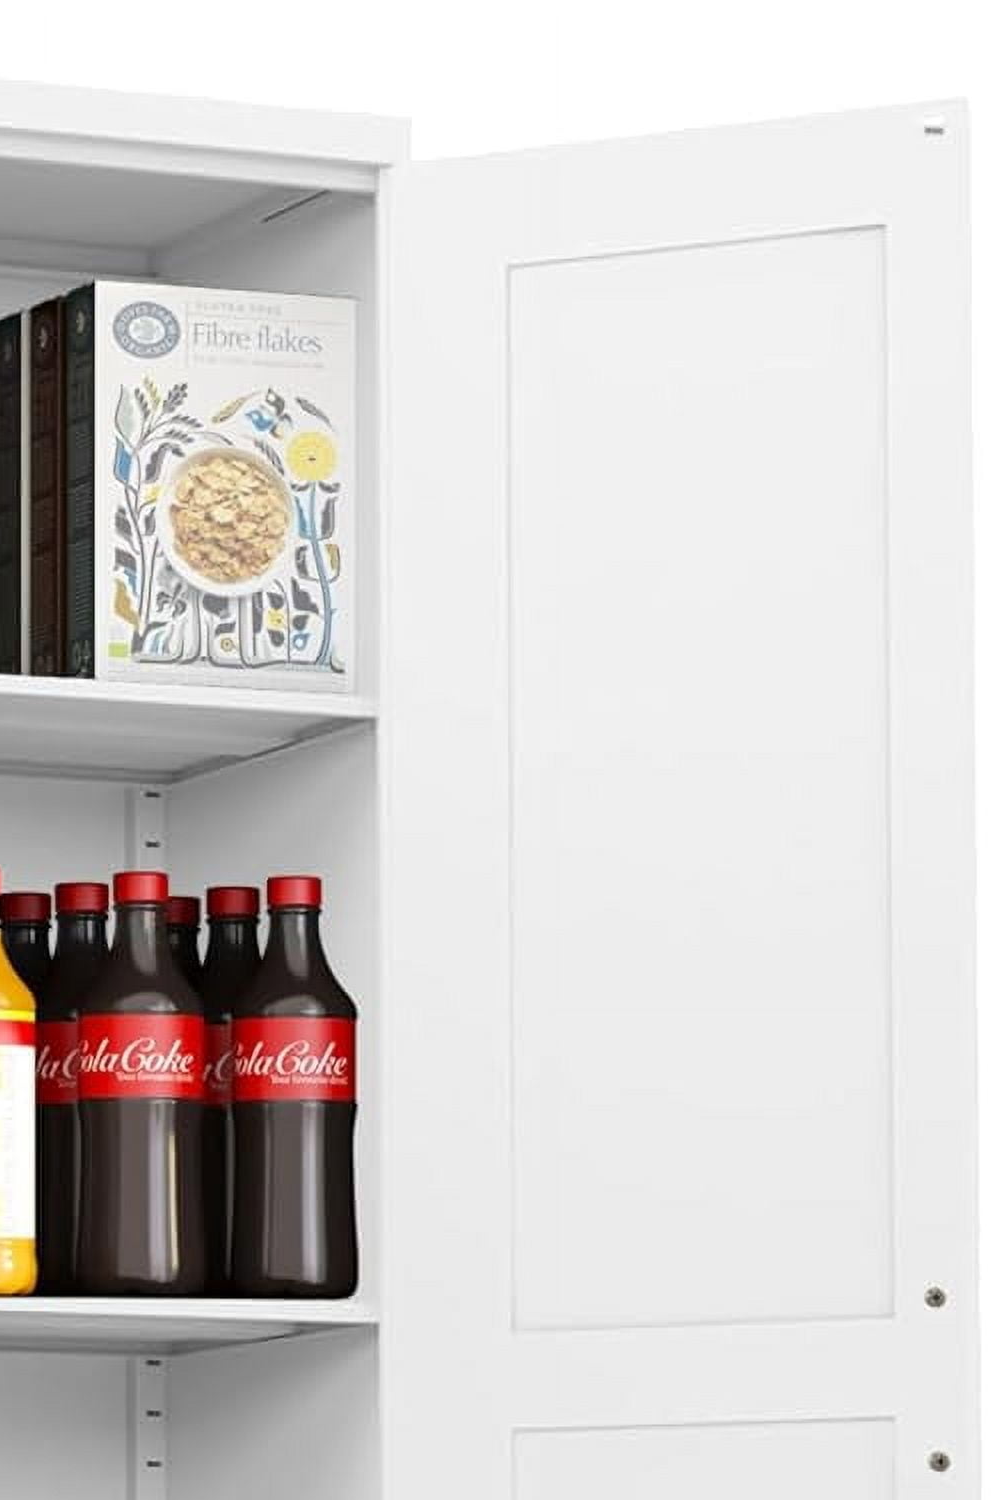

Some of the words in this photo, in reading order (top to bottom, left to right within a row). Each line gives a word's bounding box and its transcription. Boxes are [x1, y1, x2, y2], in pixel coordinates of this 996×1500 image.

[192, 321, 252, 350] Fibre
[257, 324, 324, 353] flakes
[120, 1036, 195, 1073] Coke
[274, 1039, 348, 1077] Coke
